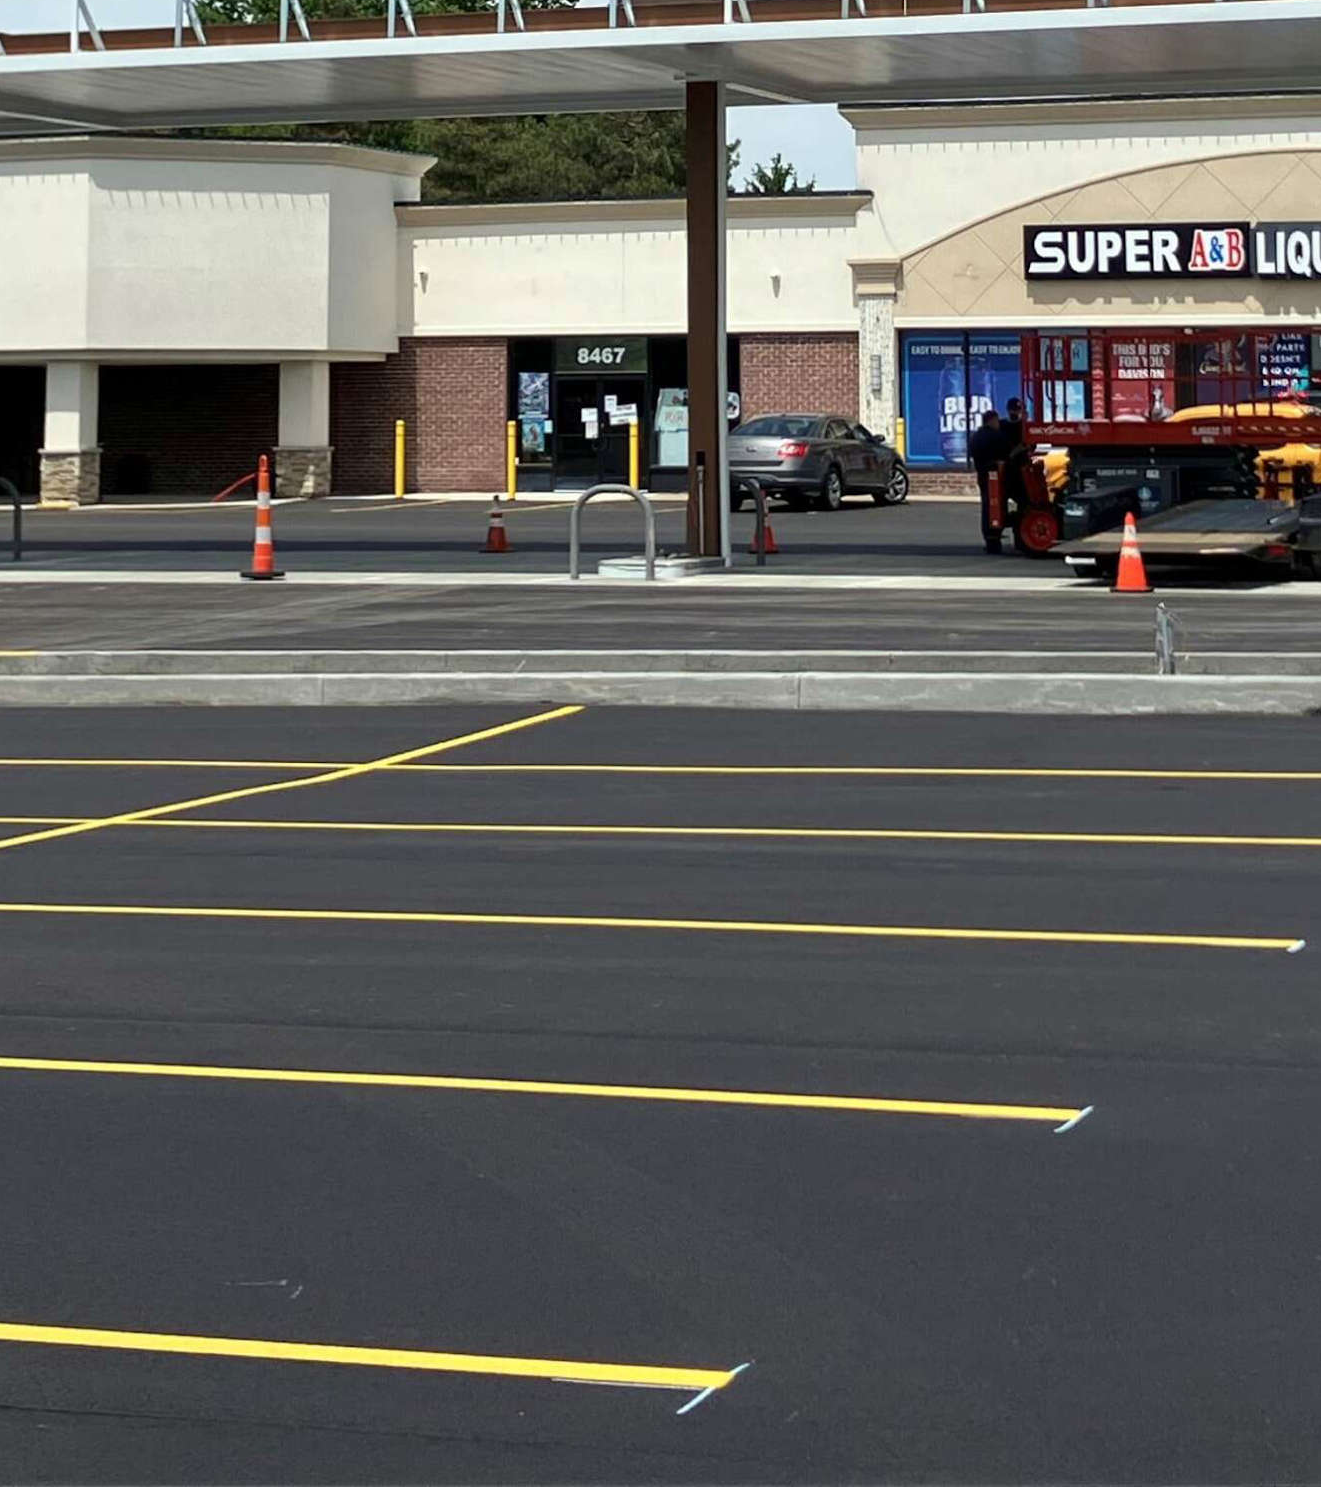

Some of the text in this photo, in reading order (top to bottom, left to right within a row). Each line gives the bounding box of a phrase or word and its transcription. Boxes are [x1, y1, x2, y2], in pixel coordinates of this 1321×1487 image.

[1028, 229, 1181, 274] SUPER
[1189, 228, 1246, 271] A&B
[577, 347, 626, 364] 8467
[1112, 343, 1136, 355] THIS
[1119, 356, 1140, 368] FOR
[944, 395, 992, 414] BUD
[940, 413, 983, 433] LIGH
